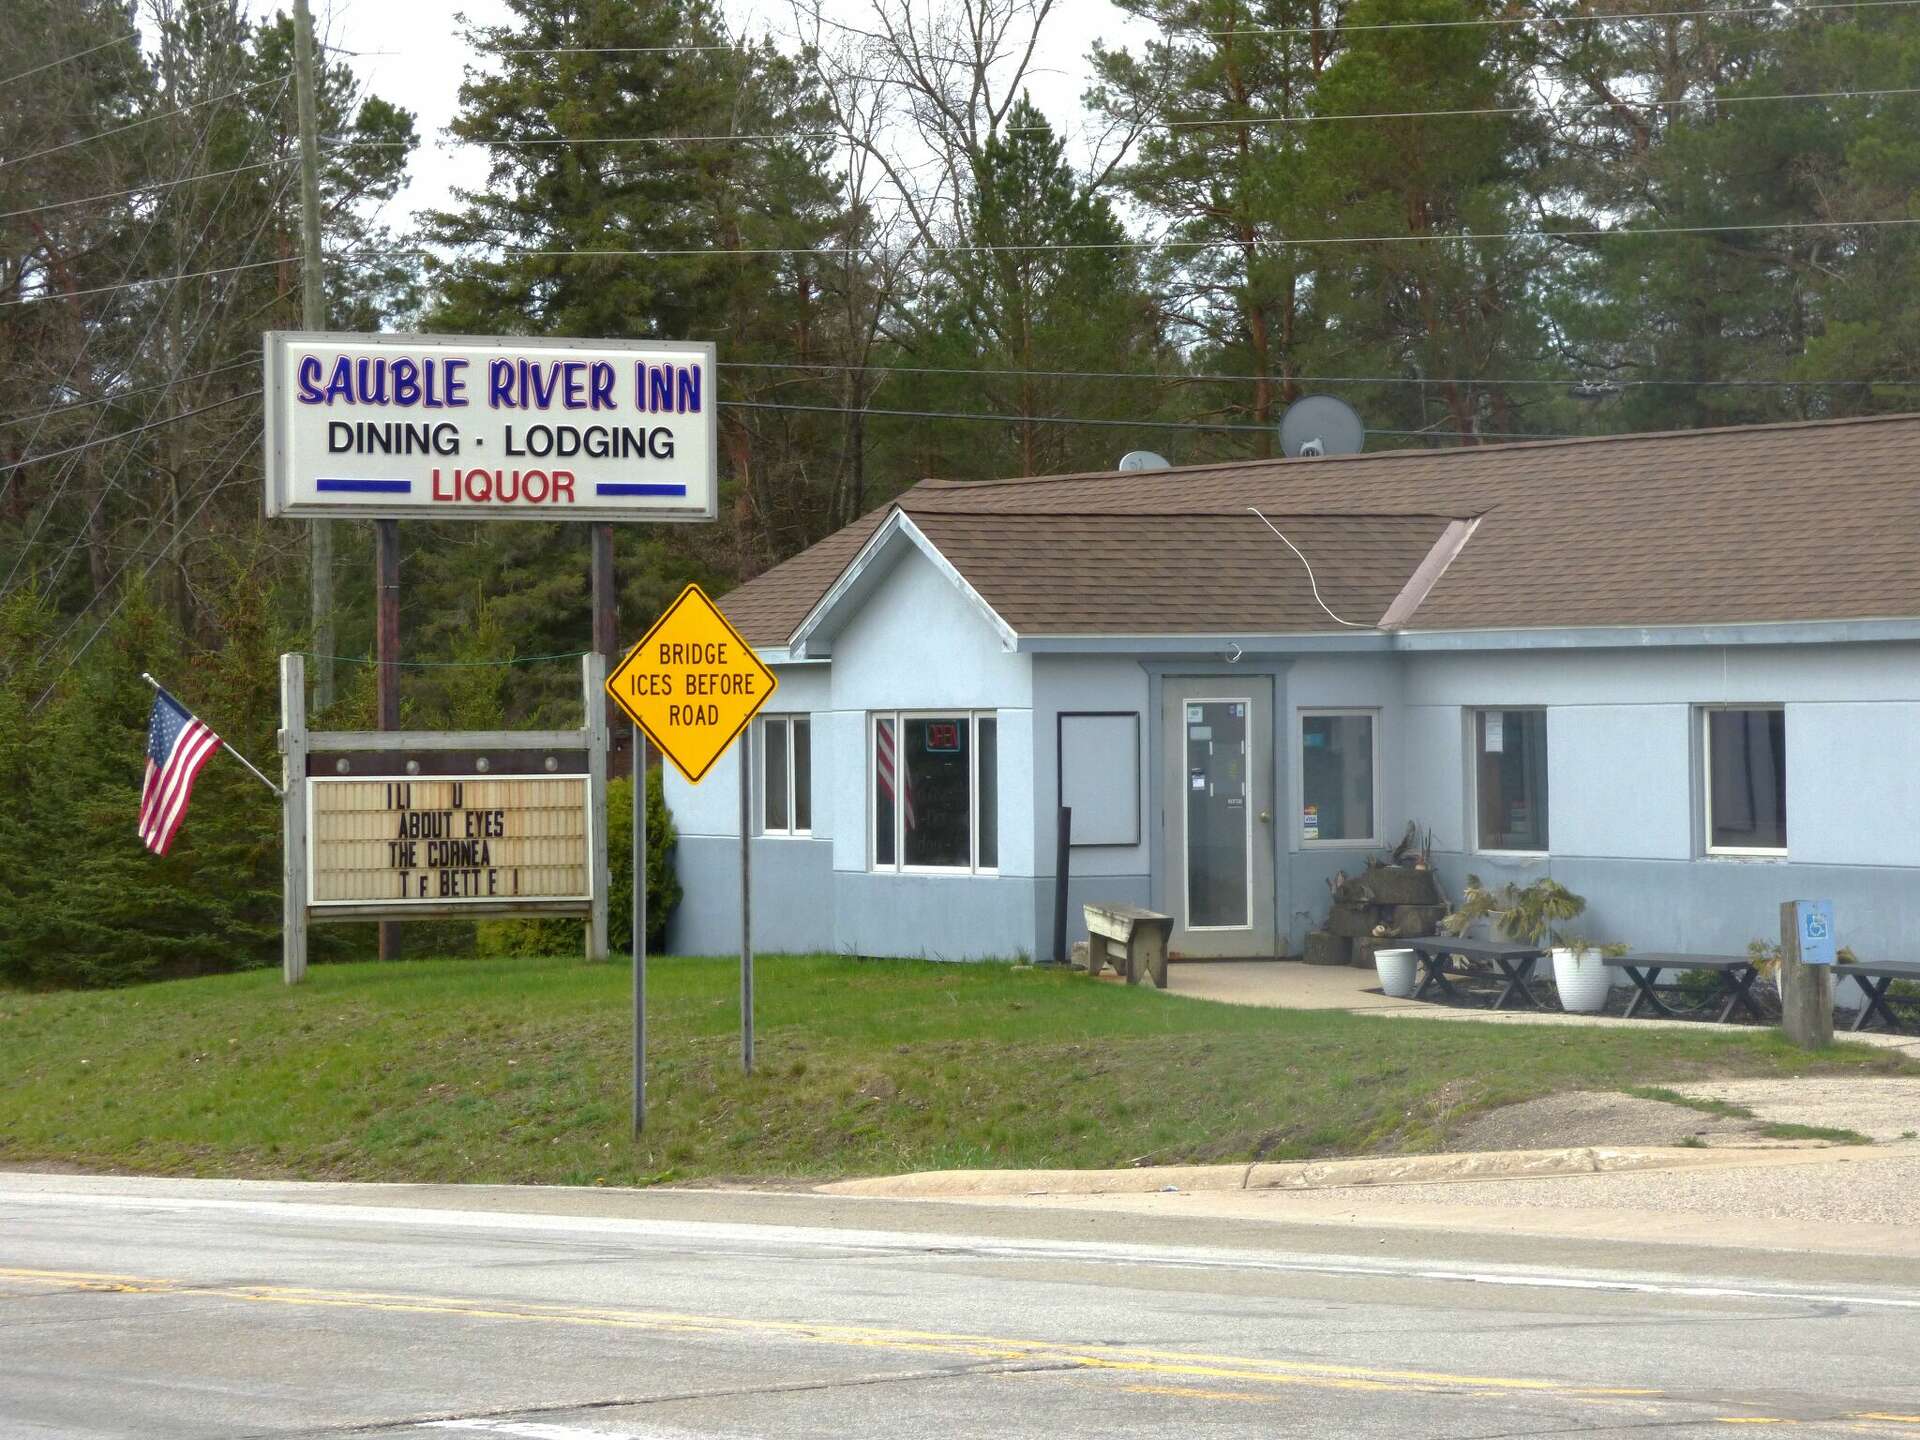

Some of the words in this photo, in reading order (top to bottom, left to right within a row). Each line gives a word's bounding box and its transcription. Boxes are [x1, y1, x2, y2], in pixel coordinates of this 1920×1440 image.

[298, 354, 469, 407] SAUBLE
[488, 357, 617, 410] RIVER
[635, 360, 701, 414] INN
[328, 421, 459, 455] DINING
[505, 425, 674, 459] LODGING
[432, 469, 575, 503] LIQUOR
[660, 643, 728, 665] BRIDGE
[631, 674, 672, 696] ICES
[686, 673, 755, 696] BEFORE
[669, 704, 719, 726] ROAD
[399, 811, 452, 838] ABOUT
[466, 810, 504, 838] EYES
[388, 841, 416, 868] THE
[428, 840, 490, 868] CORNEA
